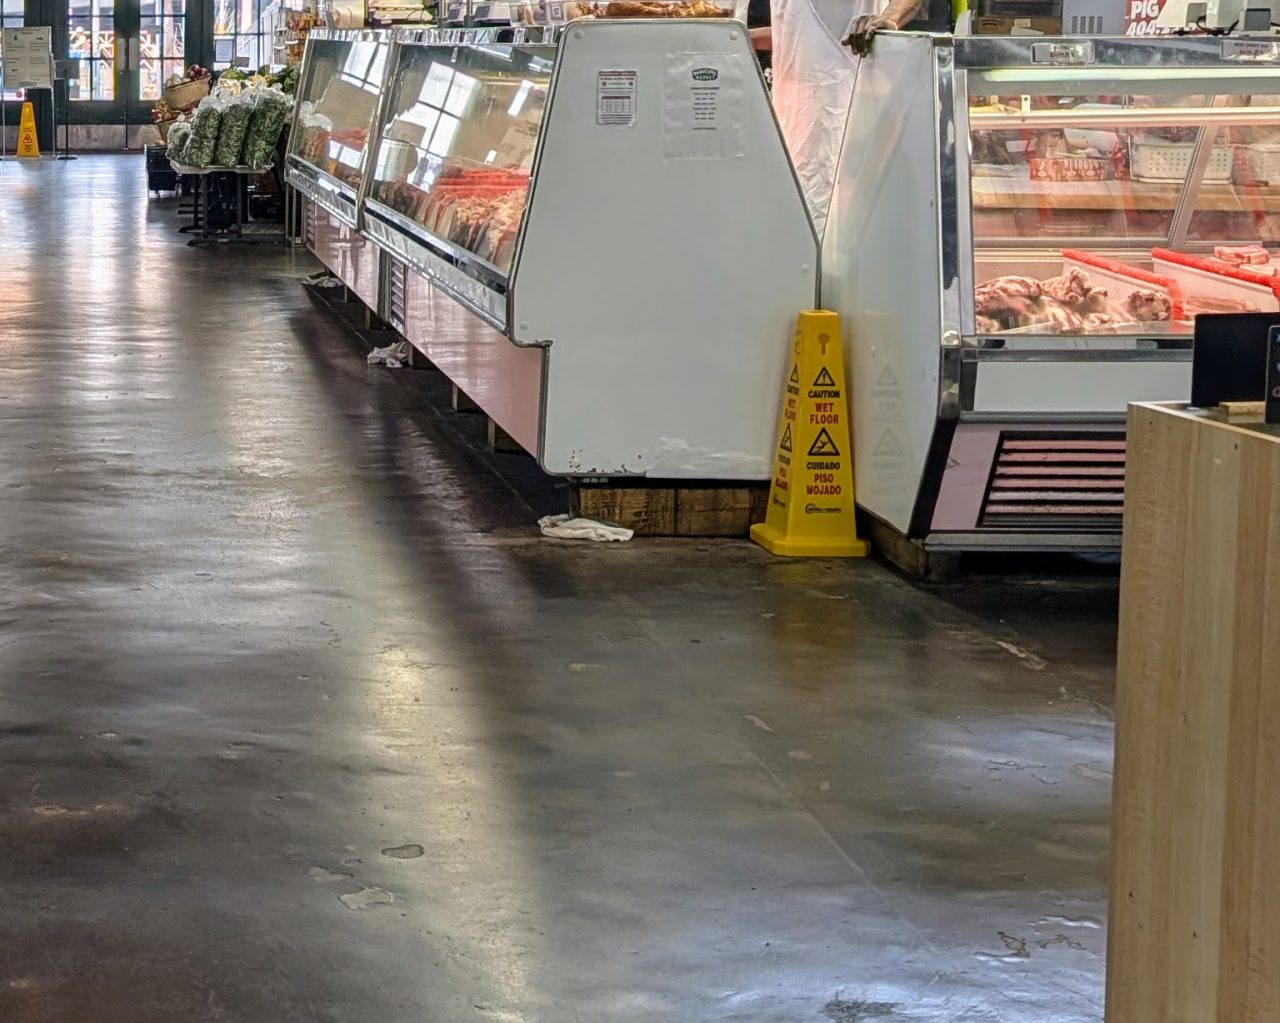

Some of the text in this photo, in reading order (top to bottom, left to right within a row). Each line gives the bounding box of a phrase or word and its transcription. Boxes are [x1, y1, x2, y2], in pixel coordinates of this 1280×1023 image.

[807, 389, 841, 399] CAUTION
[815, 401, 835, 414] WET
[809, 414, 839, 425] FLOOR
[806, 461, 841, 471] CUIDADO
[814, 473, 834, 484] PISO
[806, 484, 842, 496] MOJADO
